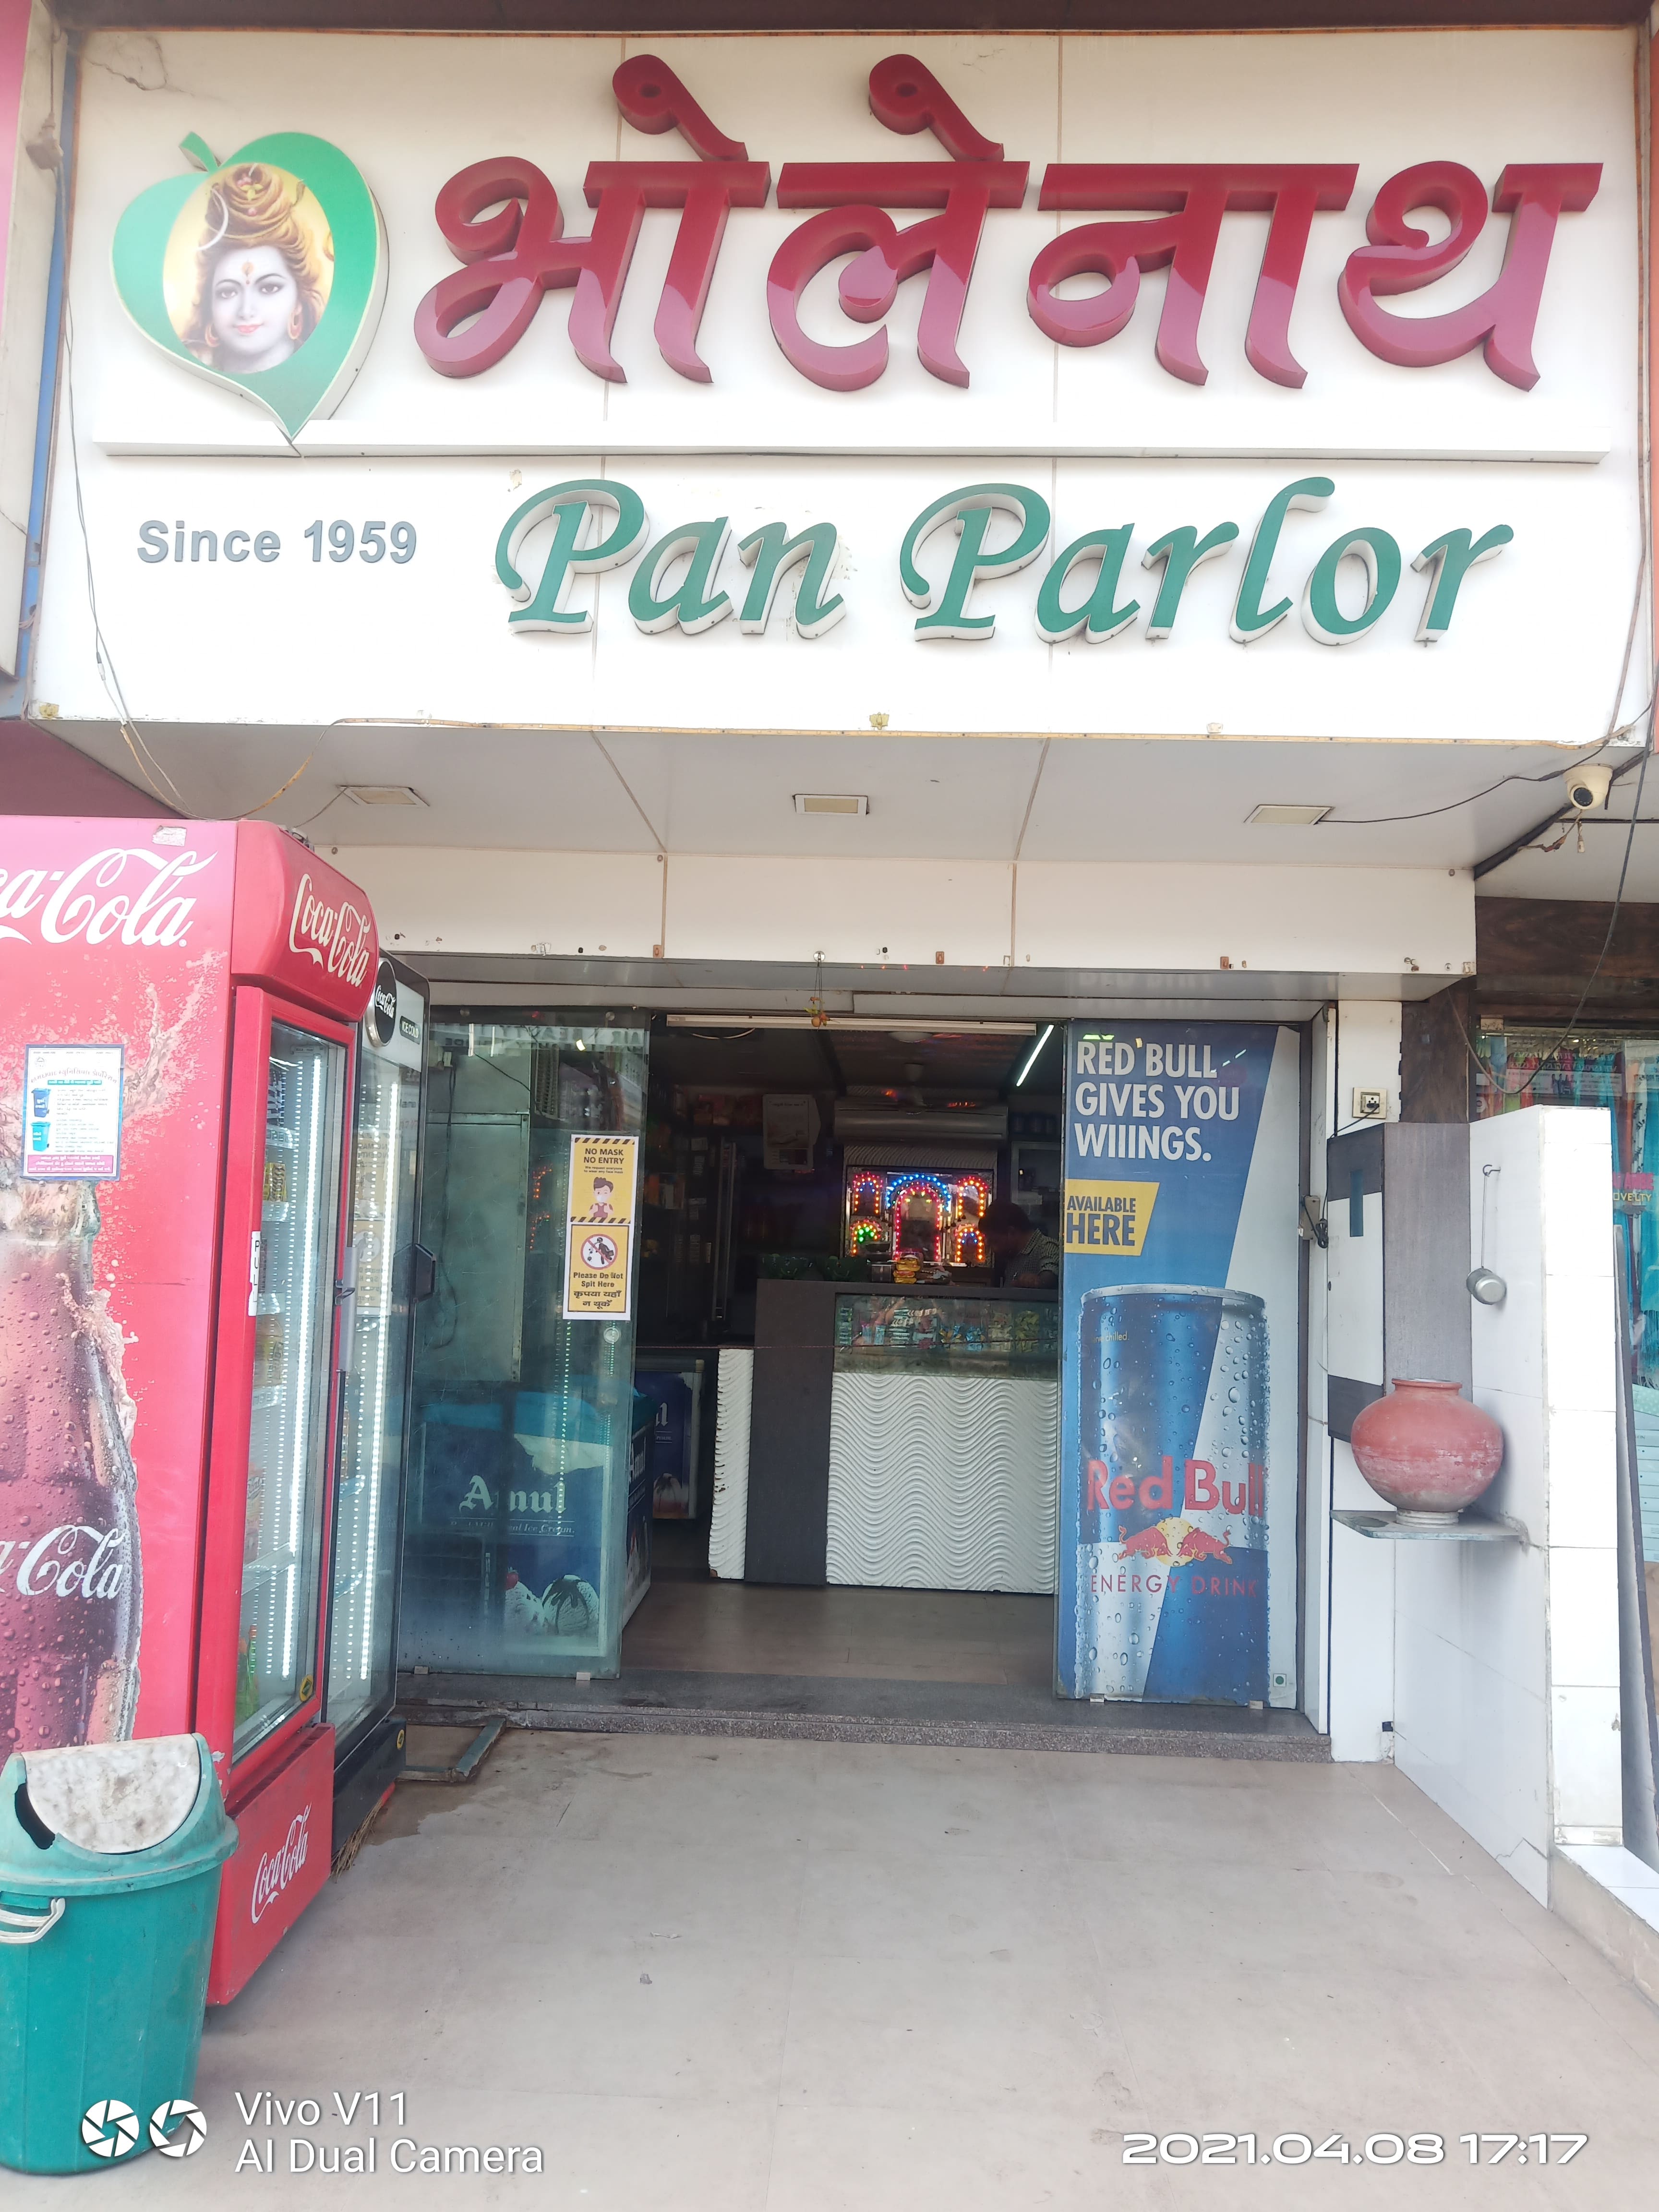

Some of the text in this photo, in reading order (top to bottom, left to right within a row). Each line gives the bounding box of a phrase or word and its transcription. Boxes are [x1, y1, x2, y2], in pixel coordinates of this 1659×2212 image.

[413, 54, 1603, 390] भोलेनाथ
[139, 520, 418, 564] Since 1959
[495, 476, 1514, 646] Pan Parlor
[289, 873, 371, 987] Coca-Cola
[375, 985, 396, 1019] Coca-Cola
[409, 1024, 419, 1038] COLD
[1076, 1041, 1217, 1079] RED BULL
[1075, 1082, 1239, 1121] GIVES YOU
[1074, 1122, 1212, 1162] WIIINGS.
[1067, 1195, 1136, 1213] AVAILABLE
[1612, 1192, 1652, 1202] OVELTY
[1066, 1213, 1135, 1246] HERE
[1105, 1330, 1130, 1342] chilled.
[1087, 1456, 1264, 1518] Red Bull
[524, 1523, 538, 1534] Ice
[1091, 1574, 1257, 1598] ENERGY DRINK
[252, 1802, 312, 1924] Coca-Cola
